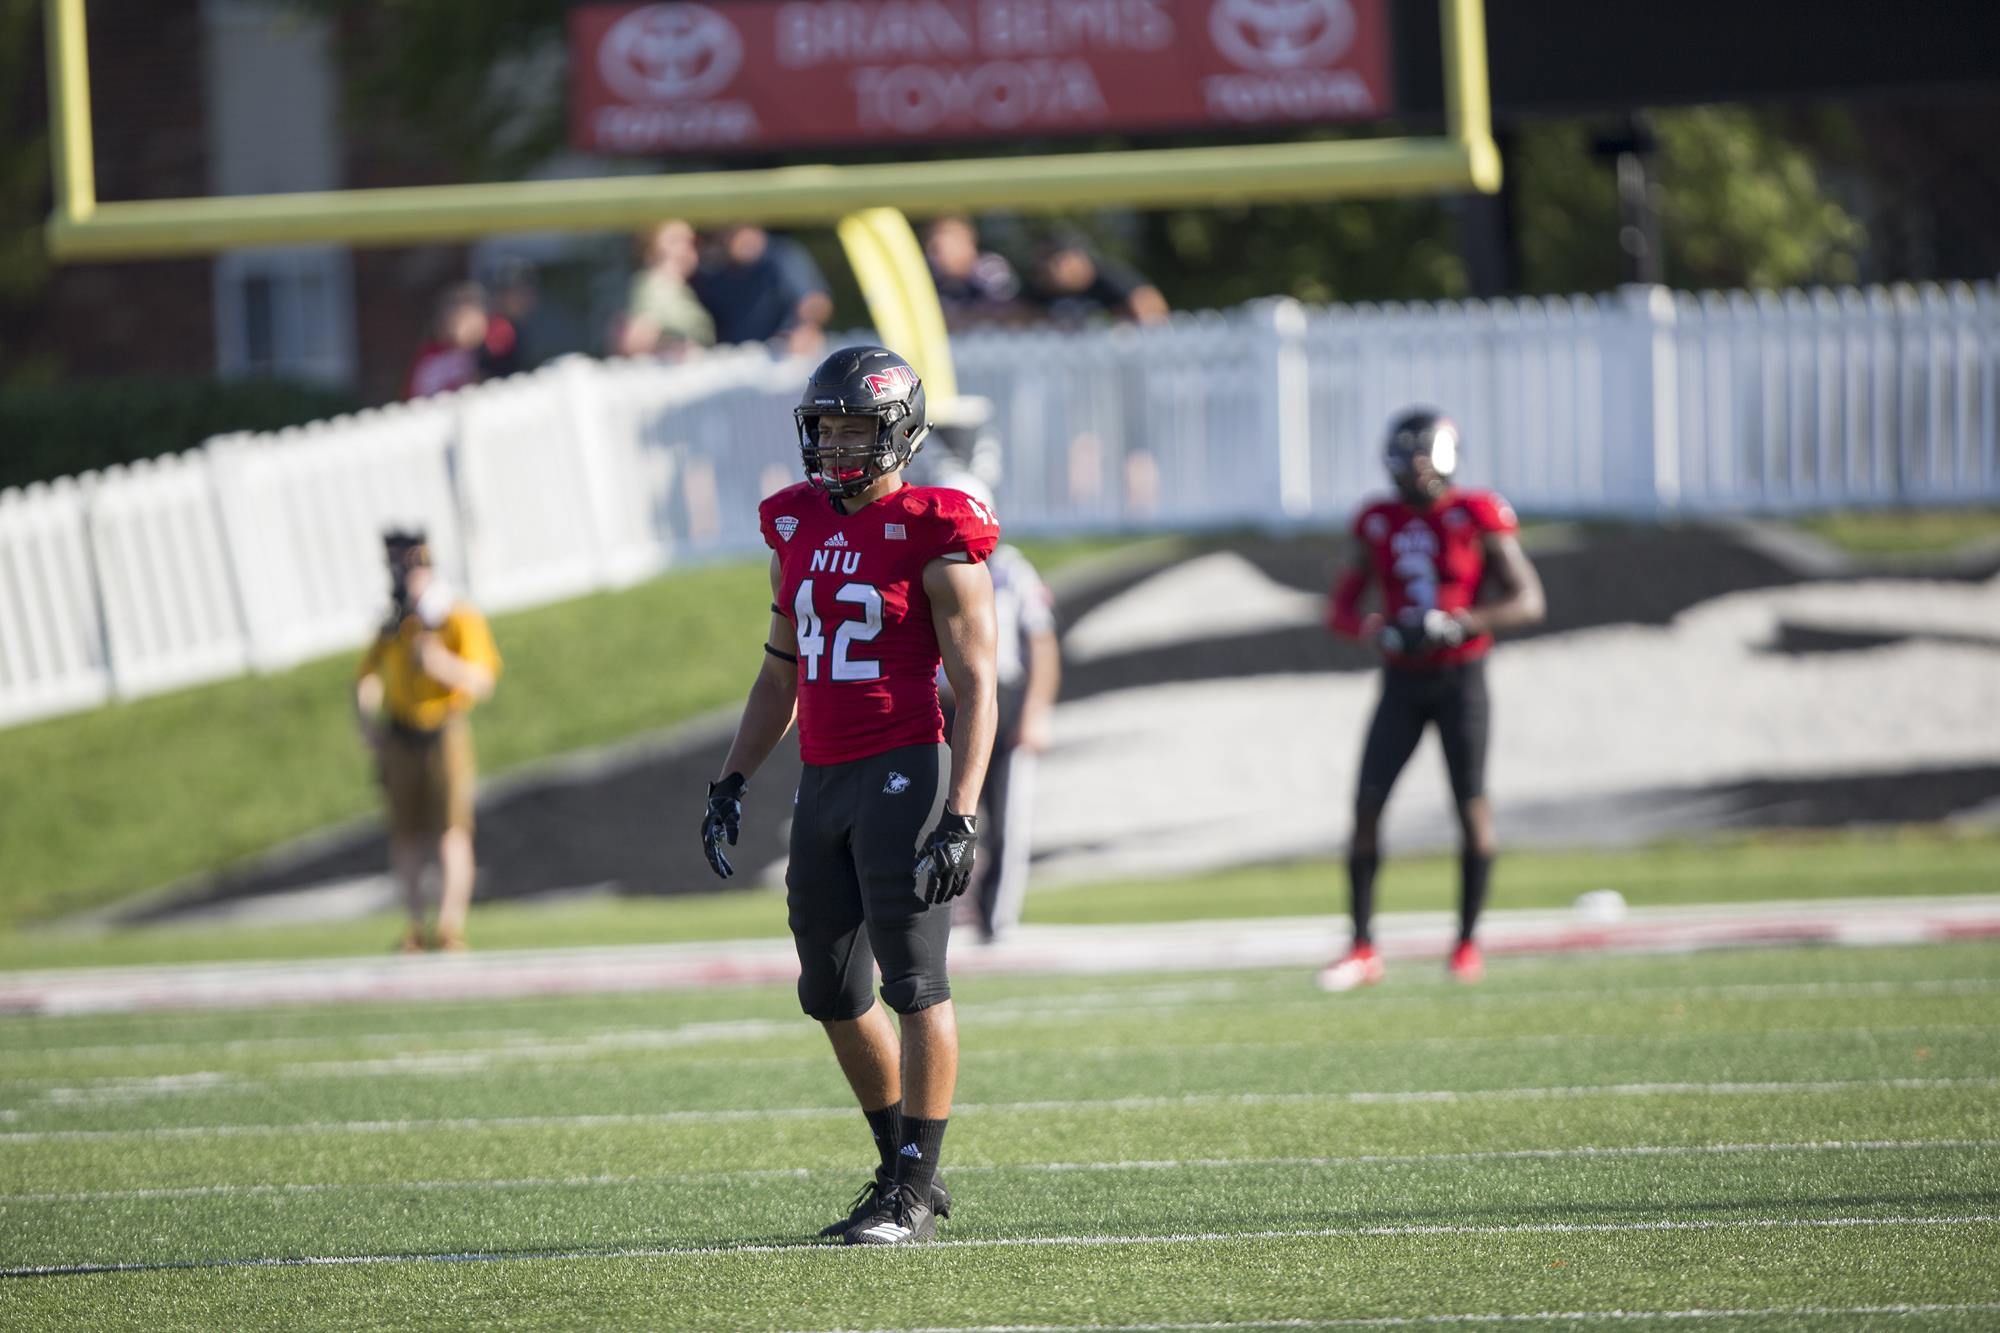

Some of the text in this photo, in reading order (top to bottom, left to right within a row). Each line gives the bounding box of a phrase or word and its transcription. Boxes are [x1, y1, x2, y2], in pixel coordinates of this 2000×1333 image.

[852, 59, 1106, 132] TOYOTA
[1201, 71, 1374, 120] TOYOTA
[810, 549, 861, 574] NIU
[793, 579, 884, 681] 42
